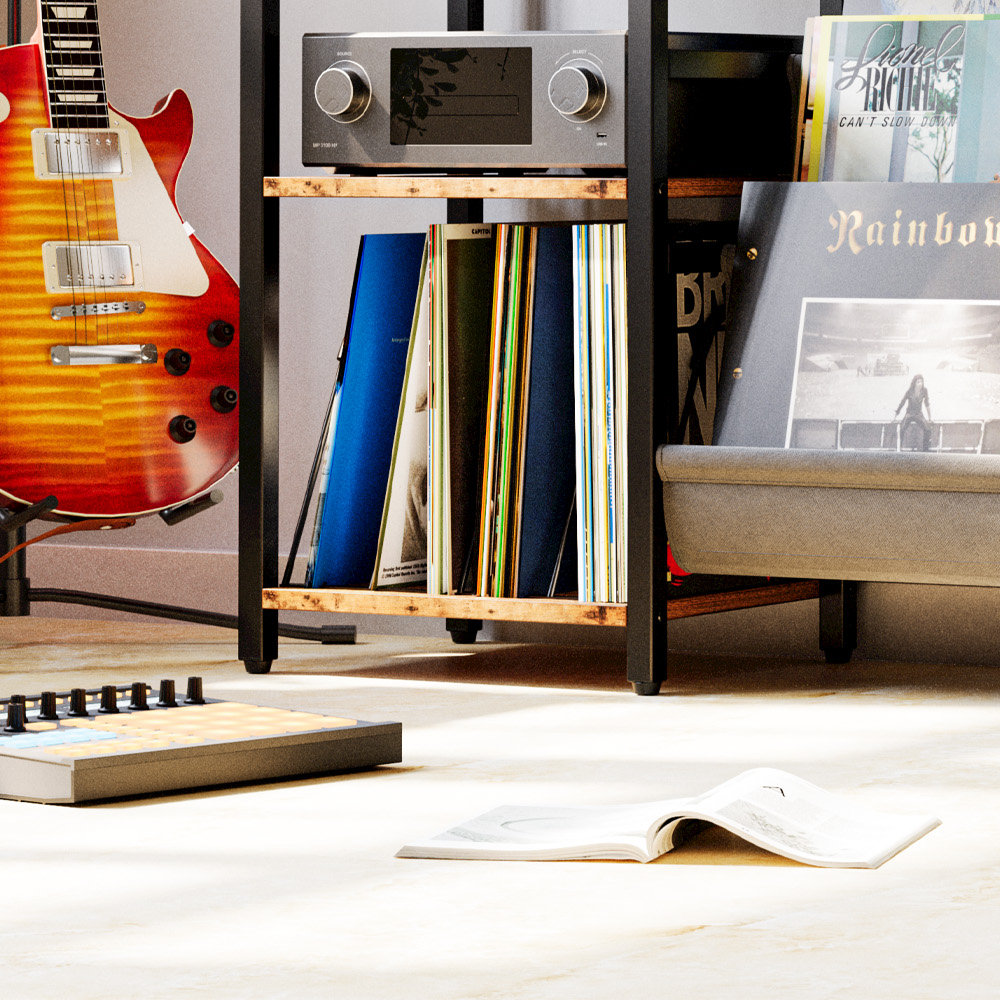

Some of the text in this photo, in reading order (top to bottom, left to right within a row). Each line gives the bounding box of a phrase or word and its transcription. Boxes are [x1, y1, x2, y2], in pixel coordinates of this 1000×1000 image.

[835, 23, 966, 93] Lionel
[863, 66, 937, 112] RICHIE
[839, 116, 957, 127] CAN'T SLOW DOWN
